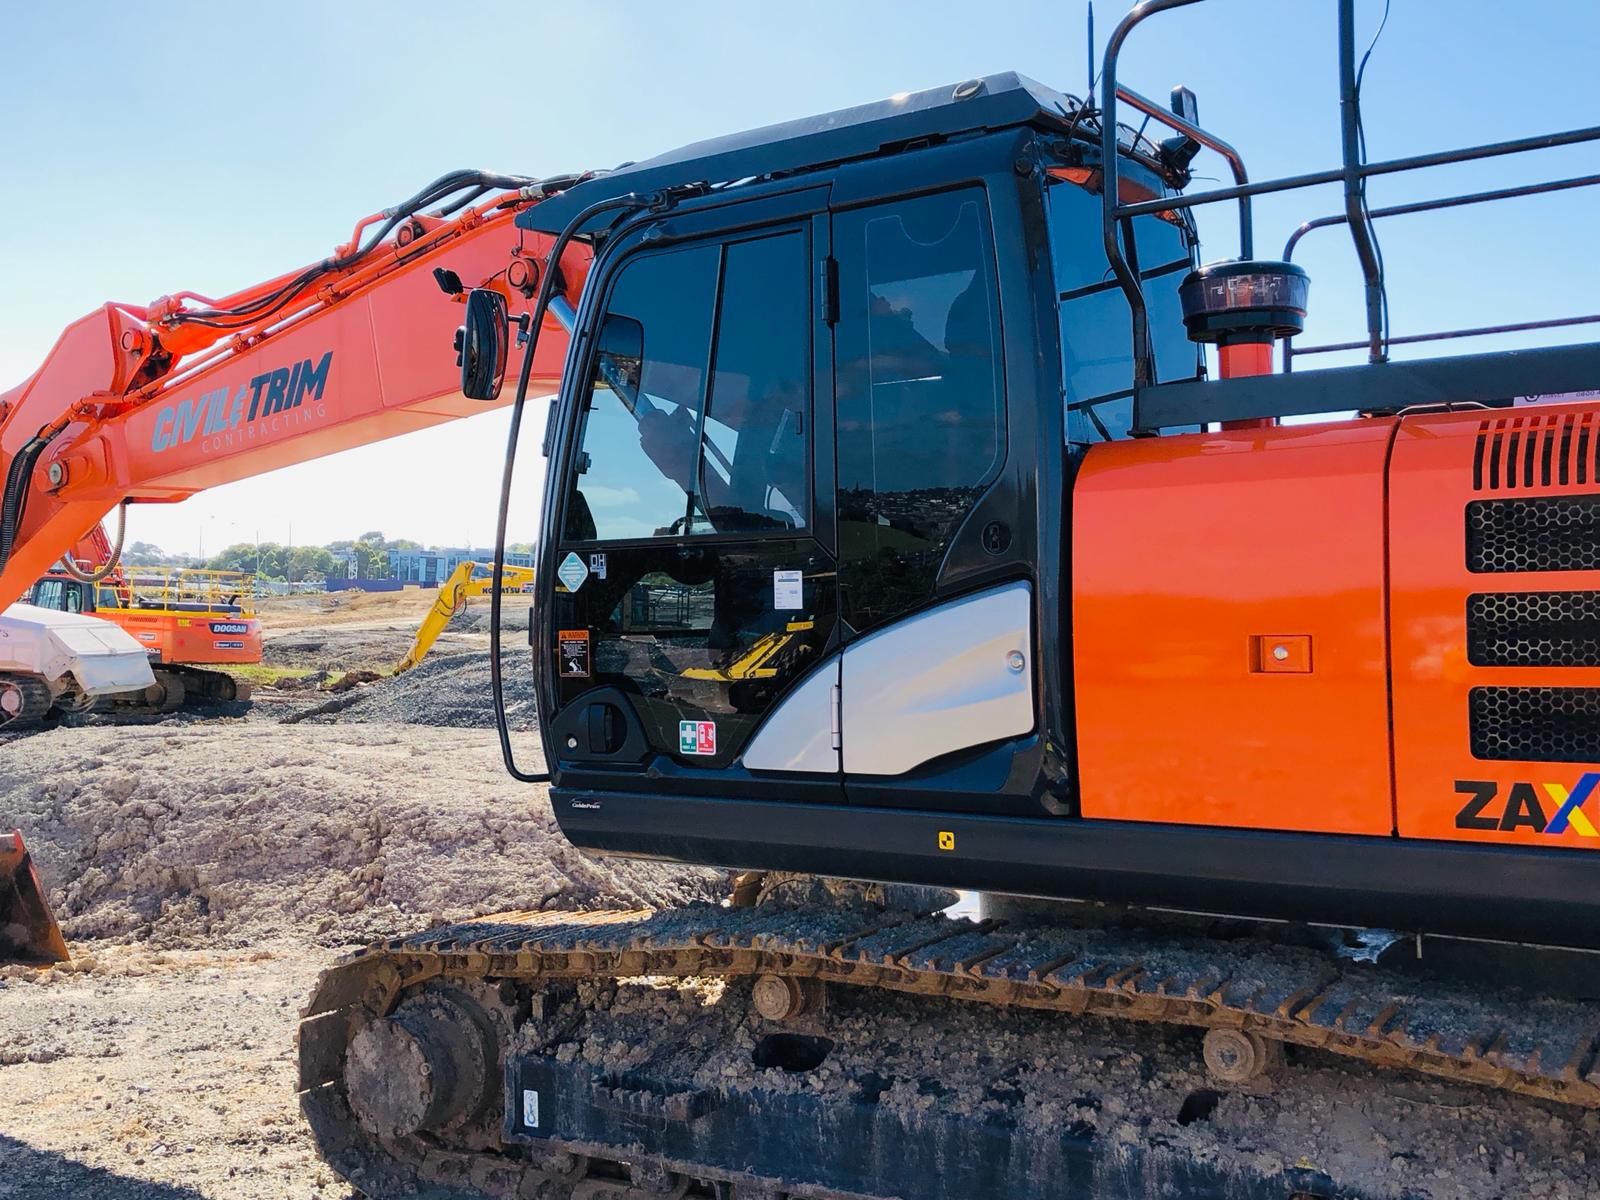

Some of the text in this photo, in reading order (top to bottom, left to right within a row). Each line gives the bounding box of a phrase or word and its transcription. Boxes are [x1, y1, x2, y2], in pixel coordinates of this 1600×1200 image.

[152, 387, 230, 453] CIVIL
[247, 351, 334, 422] TRIM
[201, 403, 327, 453] CONTRACTING
[482, 586, 520, 594] KOATSU
[213, 624, 247, 633] DOOSAN
[1454, 772, 1600, 837] ZAX
